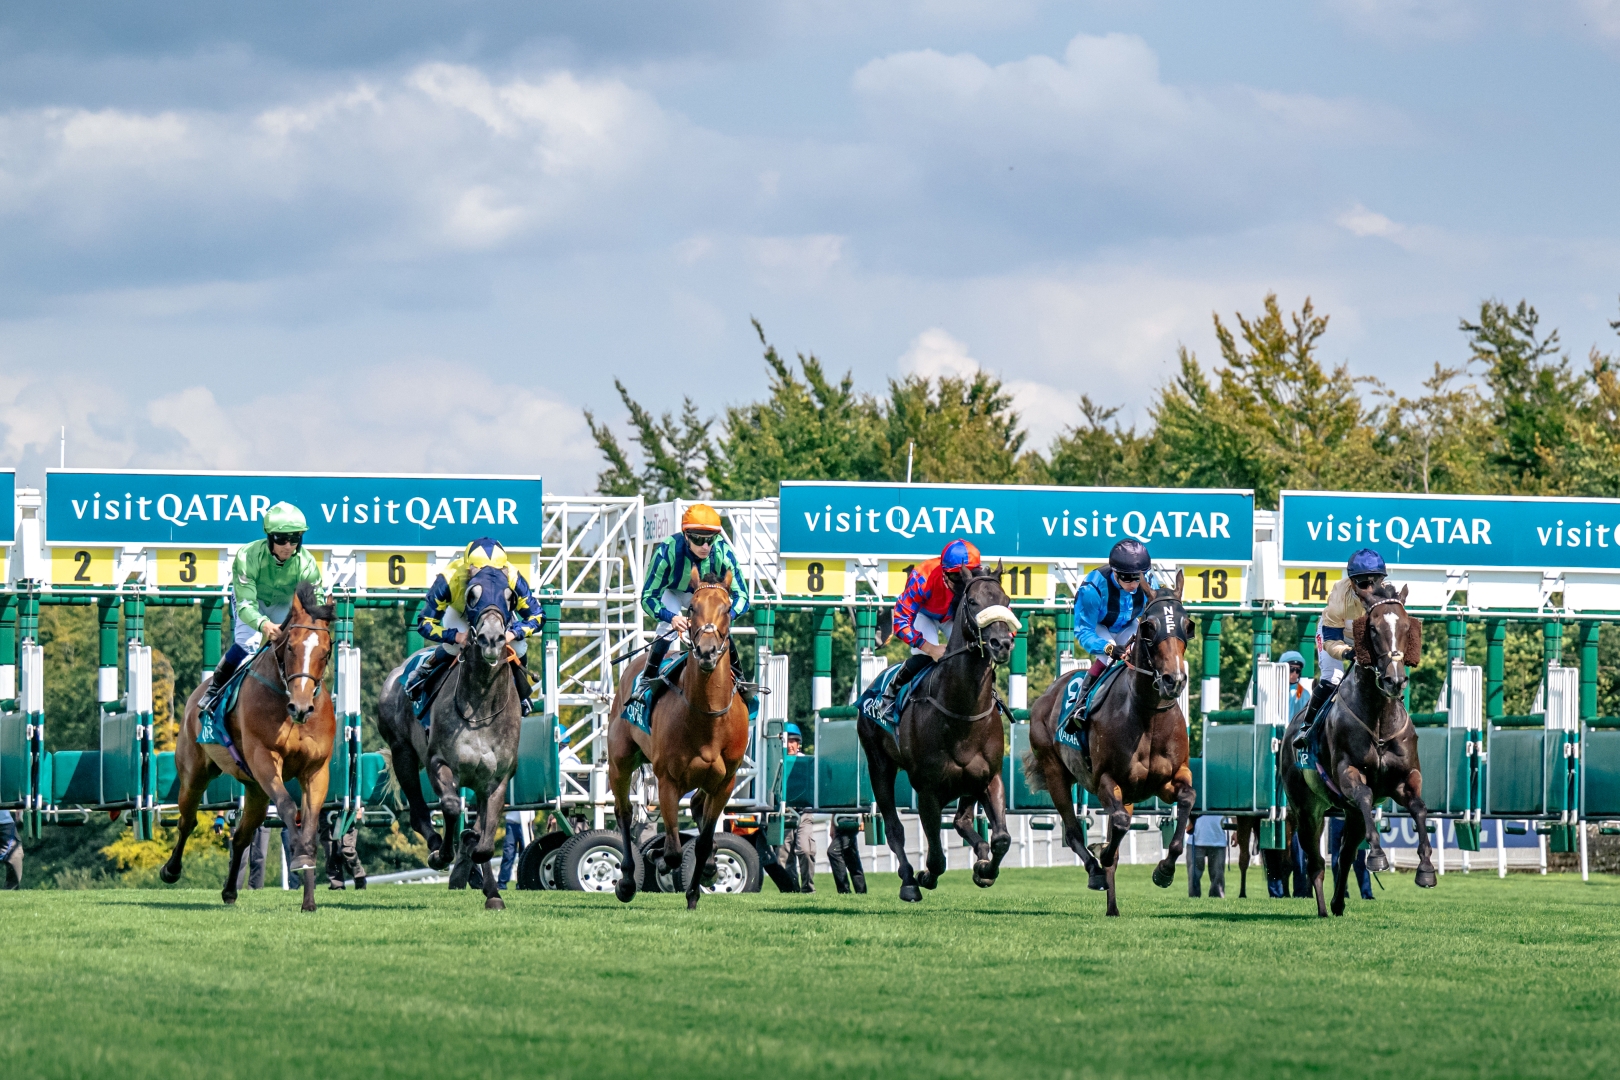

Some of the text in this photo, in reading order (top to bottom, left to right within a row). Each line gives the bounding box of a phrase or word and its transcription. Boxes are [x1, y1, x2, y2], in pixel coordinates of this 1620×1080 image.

[74, 551, 91, 582] 2
[179, 552, 197, 583] 3
[388, 554, 406, 585] 6
[807, 562, 824, 592] 8
[1009, 566, 1032, 596] 11
[1198, 569, 1228, 599] 13
[1298, 571, 1328, 601] 14
[1163, 606, 1176, 634] NEF
